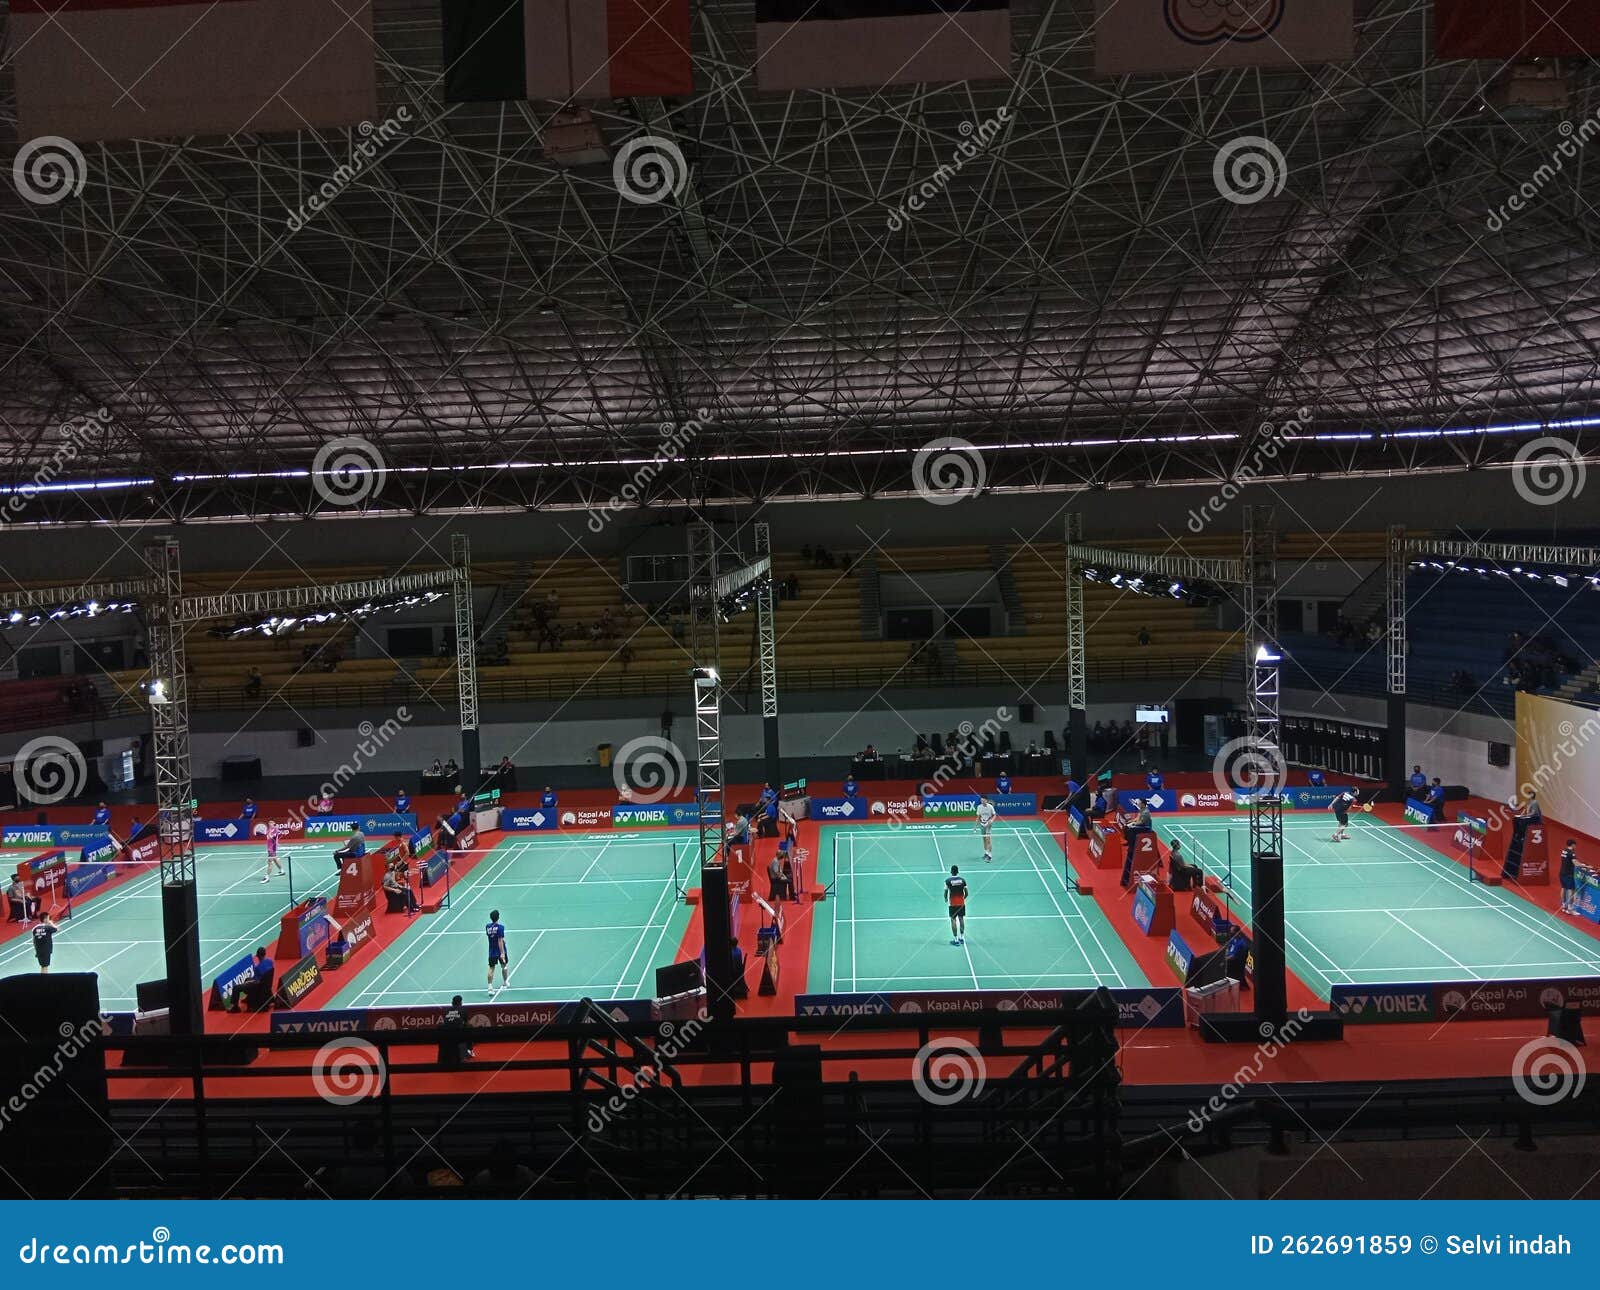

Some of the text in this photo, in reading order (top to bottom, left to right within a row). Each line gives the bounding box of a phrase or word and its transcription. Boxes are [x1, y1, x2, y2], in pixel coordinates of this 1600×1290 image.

[944, 801, 976, 812] YONEX
[578, 810, 611, 819] Kapal Api
[634, 810, 665, 822] YONEX
[327, 821, 358, 833] YONE
[23, 831, 52, 842] YONEX
[1532, 830, 1543, 844] 3
[1141, 838, 1152, 851] 2
[736, 850, 743, 863] 1
[346, 862, 358, 876] 4
[1471, 987, 1527, 1002] Kapal Api
[927, 1000, 983, 1013] Kapal Api
[1373, 994, 1428, 1013] YONEX
[1471, 1000, 1506, 1012] Group
[401, 1014, 434, 1027] Kapal
[496, 1010, 551, 1025] Kapal Api
